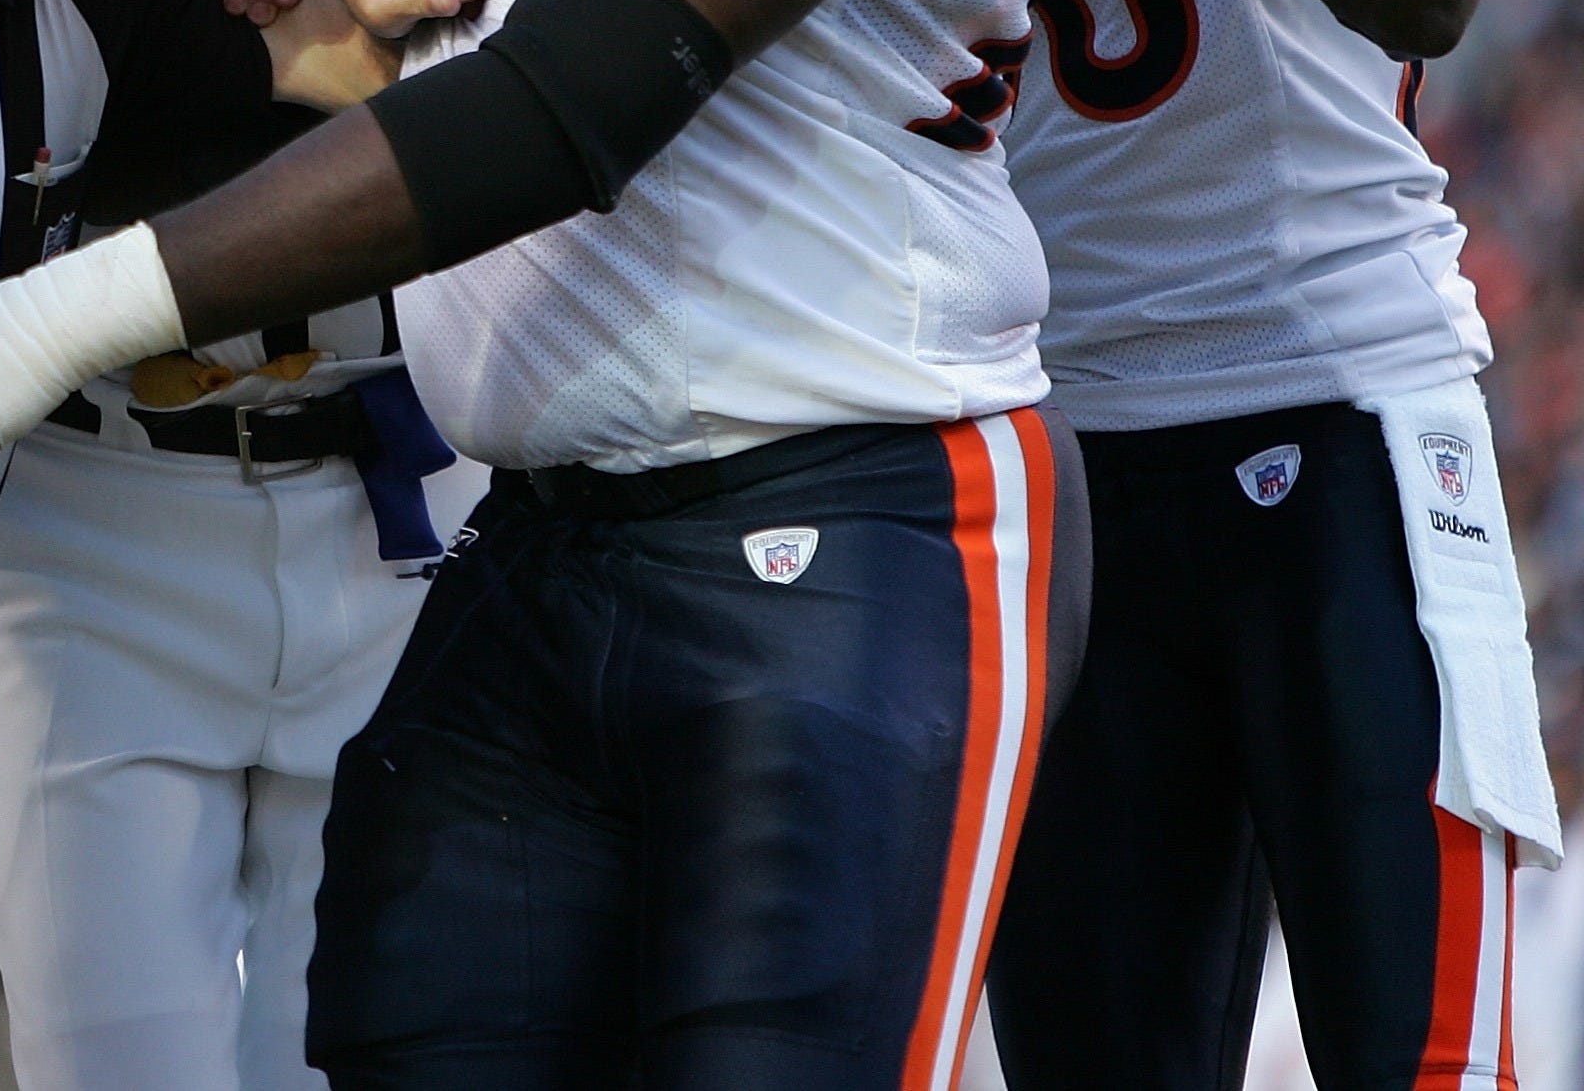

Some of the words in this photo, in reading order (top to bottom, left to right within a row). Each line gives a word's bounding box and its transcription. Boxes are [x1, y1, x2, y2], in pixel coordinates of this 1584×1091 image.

[1422, 436, 1469, 458] EQUIPMENT
[1428, 509, 1490, 543] Wilson
[767, 557, 798, 575] NFL
